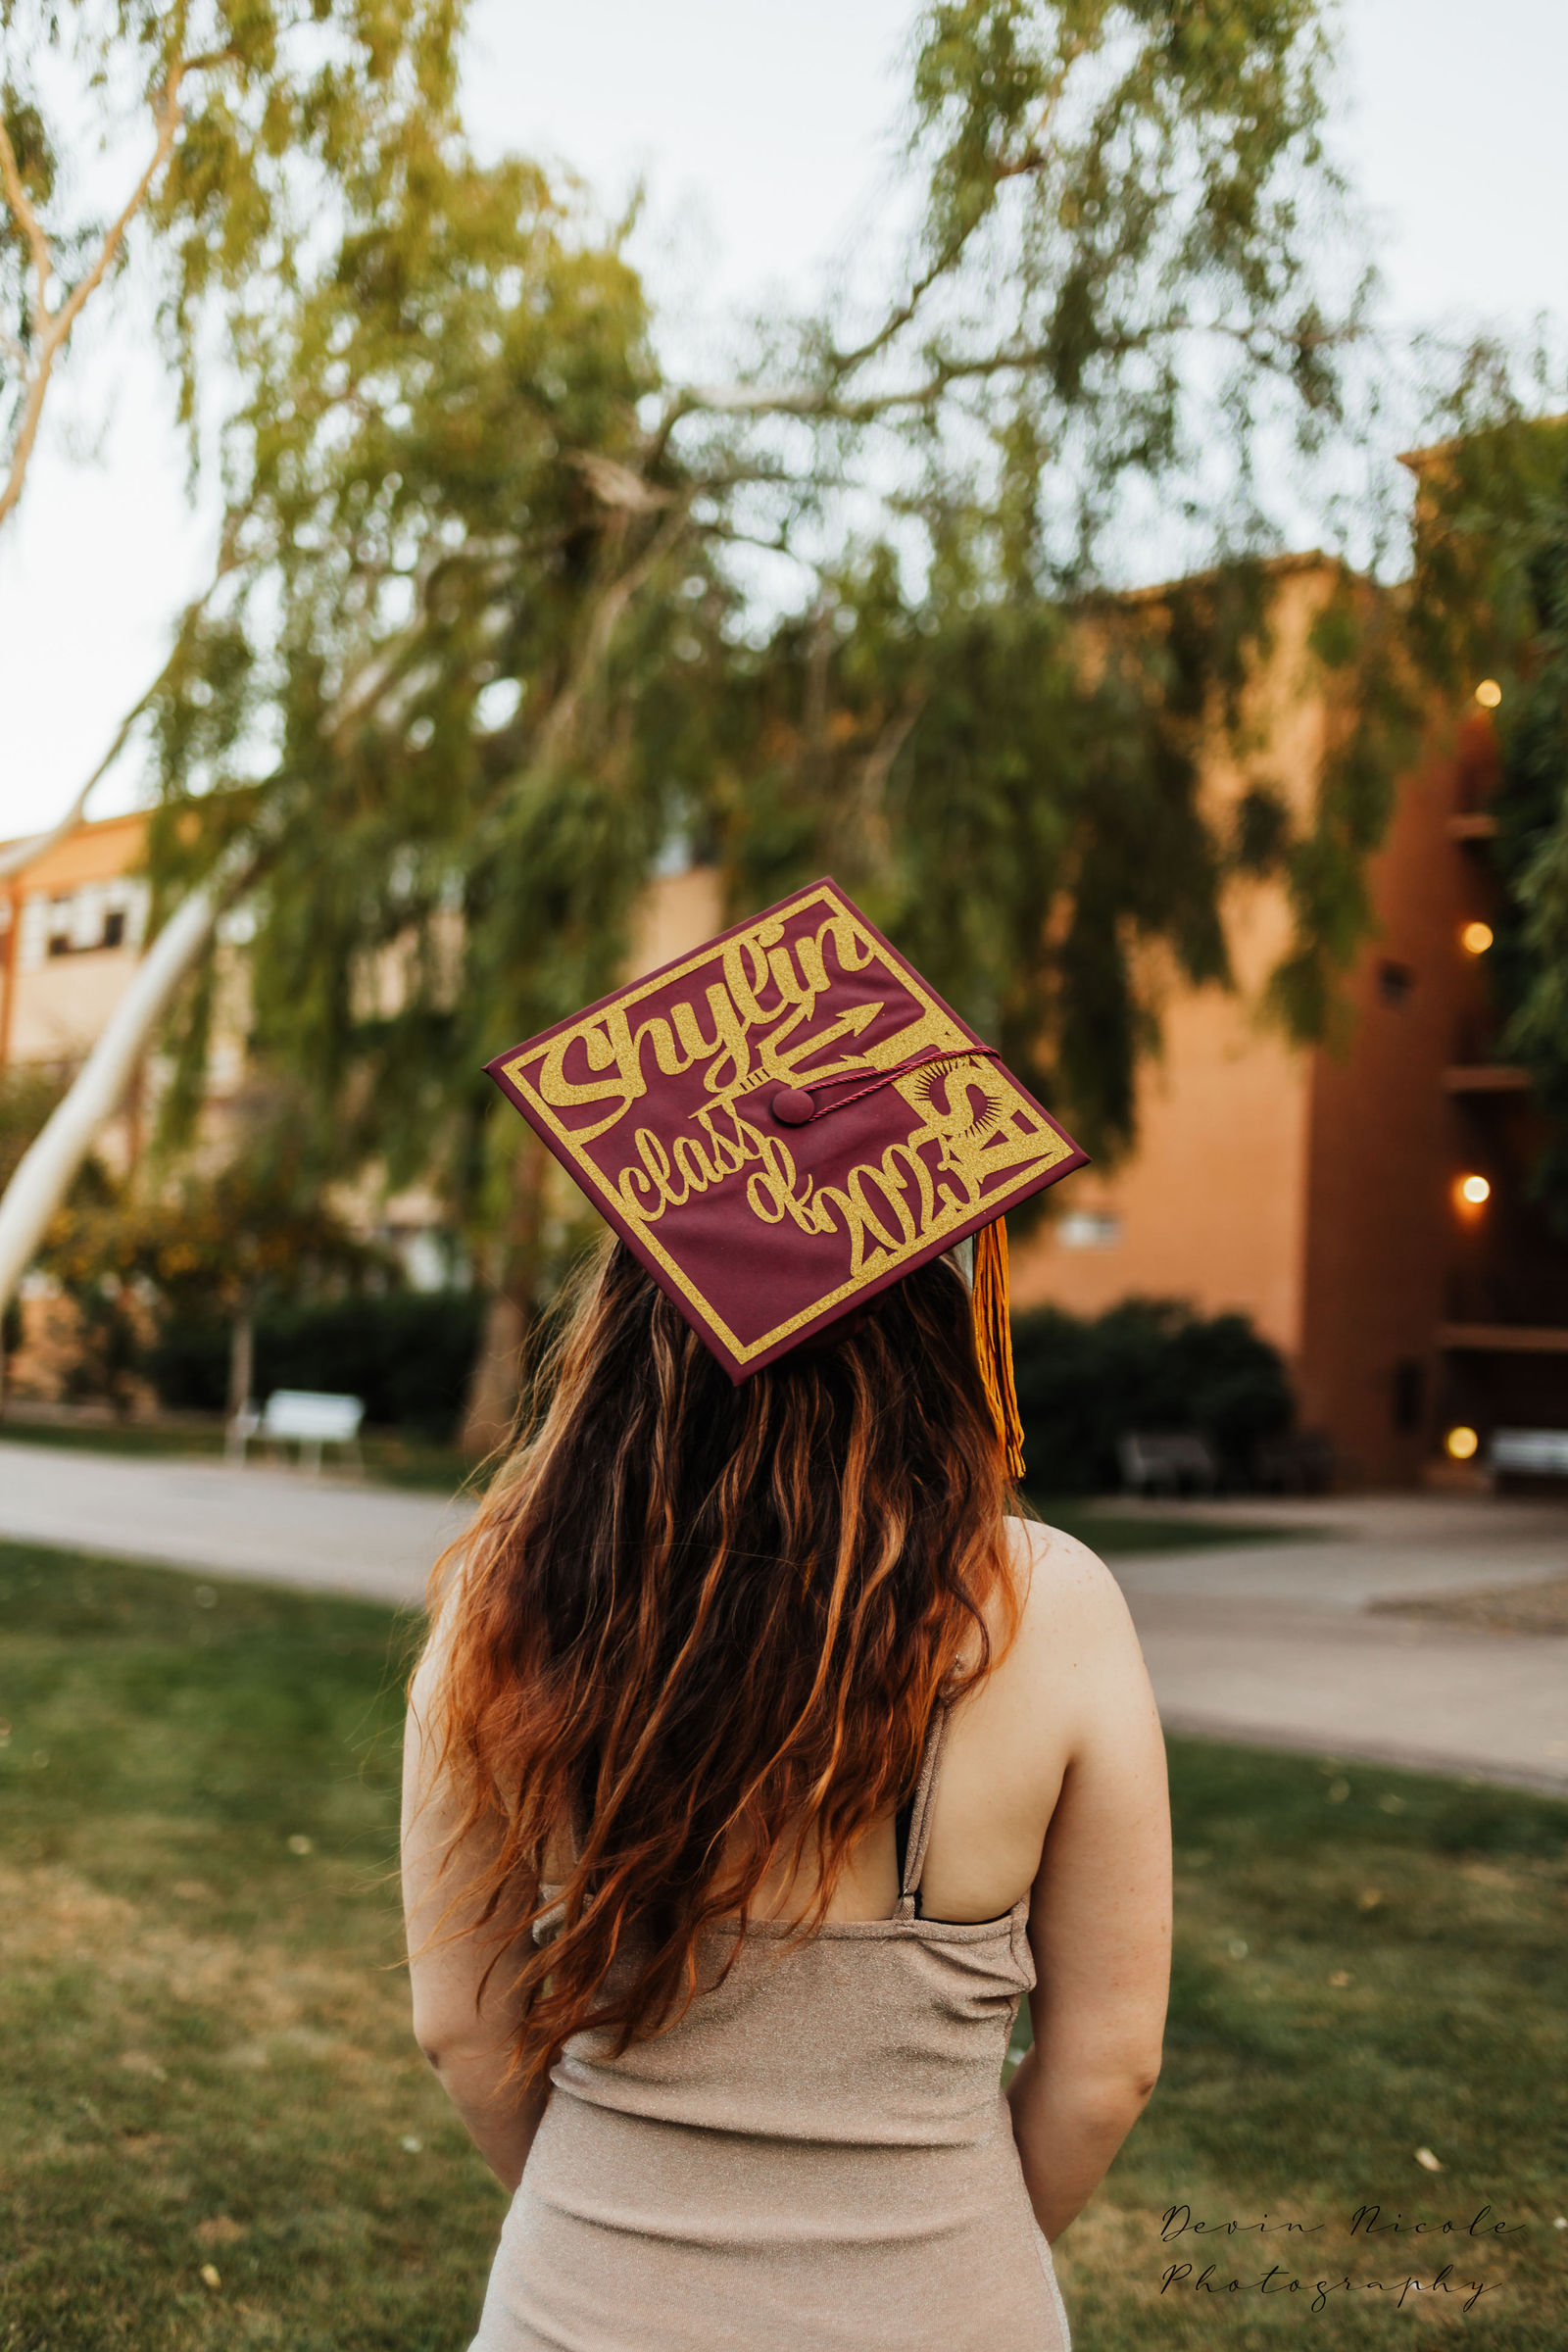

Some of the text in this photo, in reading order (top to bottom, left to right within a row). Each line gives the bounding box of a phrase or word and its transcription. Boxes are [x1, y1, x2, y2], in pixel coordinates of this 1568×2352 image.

[539, 915, 876, 1145] Shylin
[617, 1100, 983, 1278] class of 2023
